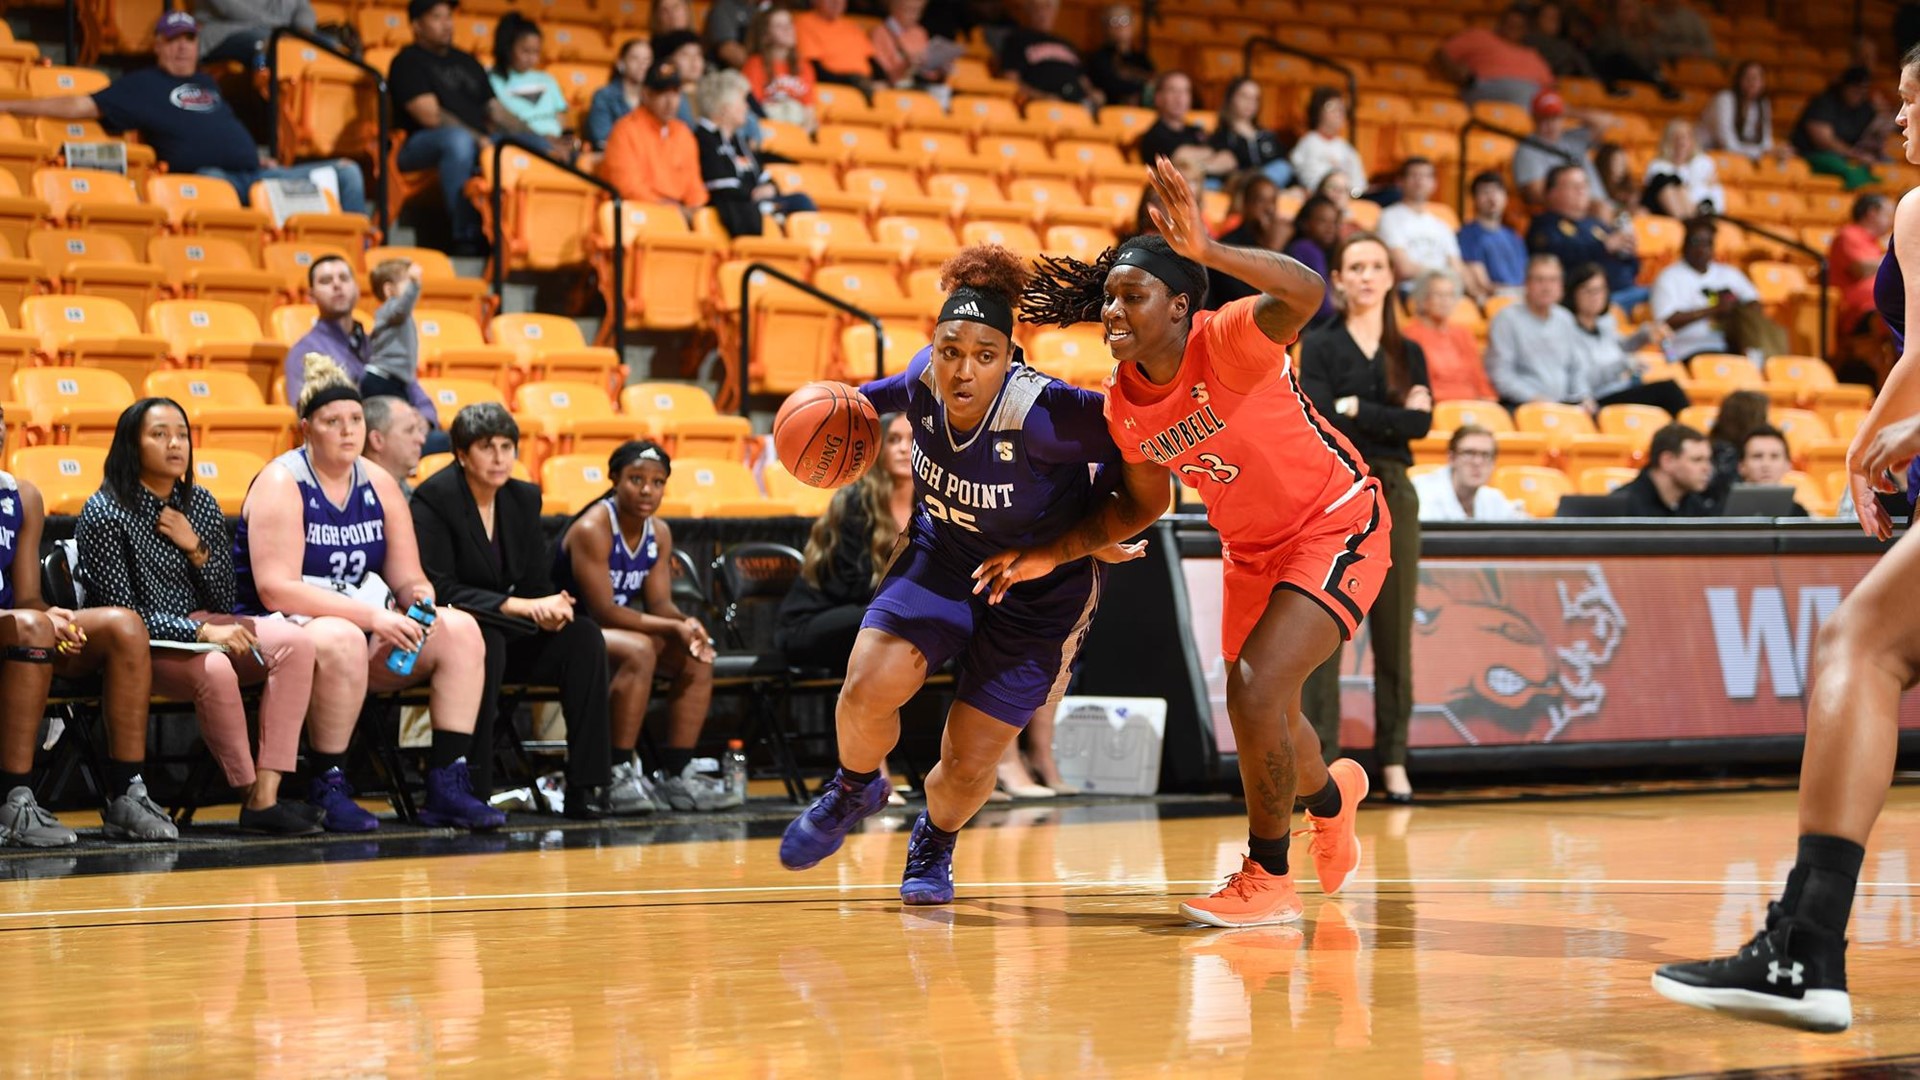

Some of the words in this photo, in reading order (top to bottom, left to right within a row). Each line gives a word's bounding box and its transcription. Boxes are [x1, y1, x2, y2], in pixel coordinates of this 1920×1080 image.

[1140, 403, 1227, 464] CAMPBELL
[911, 438, 944, 492] HIGH
[944, 472, 1014, 510] POINT
[306, 521, 341, 546] HIGH
[340, 518, 384, 547] POINT
[328, 549, 367, 584] 33
